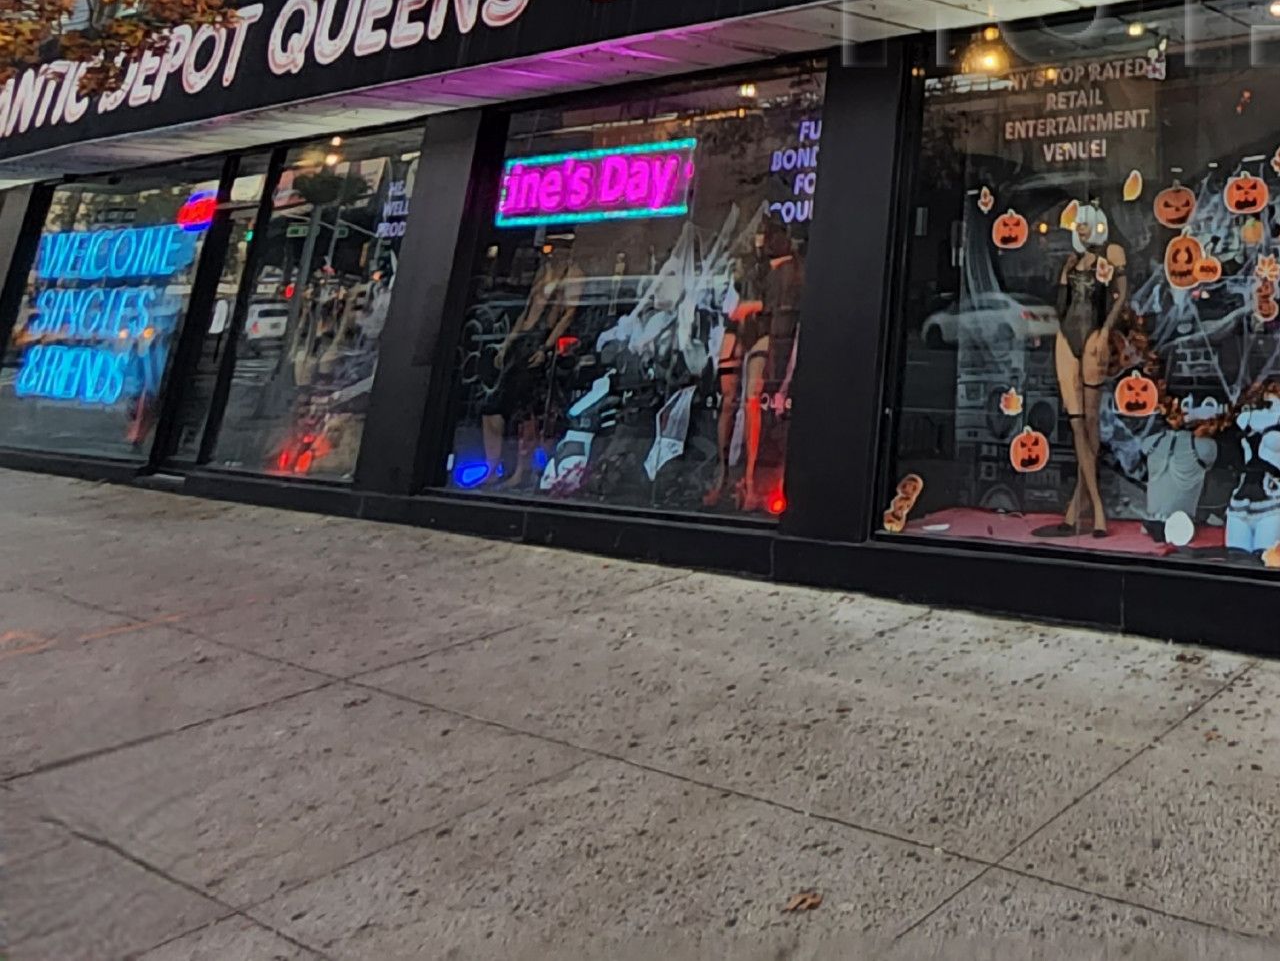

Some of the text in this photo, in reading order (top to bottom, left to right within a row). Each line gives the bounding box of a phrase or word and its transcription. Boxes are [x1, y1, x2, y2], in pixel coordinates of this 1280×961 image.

[1007, 58, 1148, 92] NY'S TOP RATED
[1046, 89, 1103, 112] RETAIL
[1005, 109, 1150, 140] ENTERTAINMENT
[1043, 139, 1107, 163] VENUE!
[501, 154, 682, 215] ine's Day
[39, 226, 182, 279] WELCOME
[31, 285, 156, 336] SINGLES
